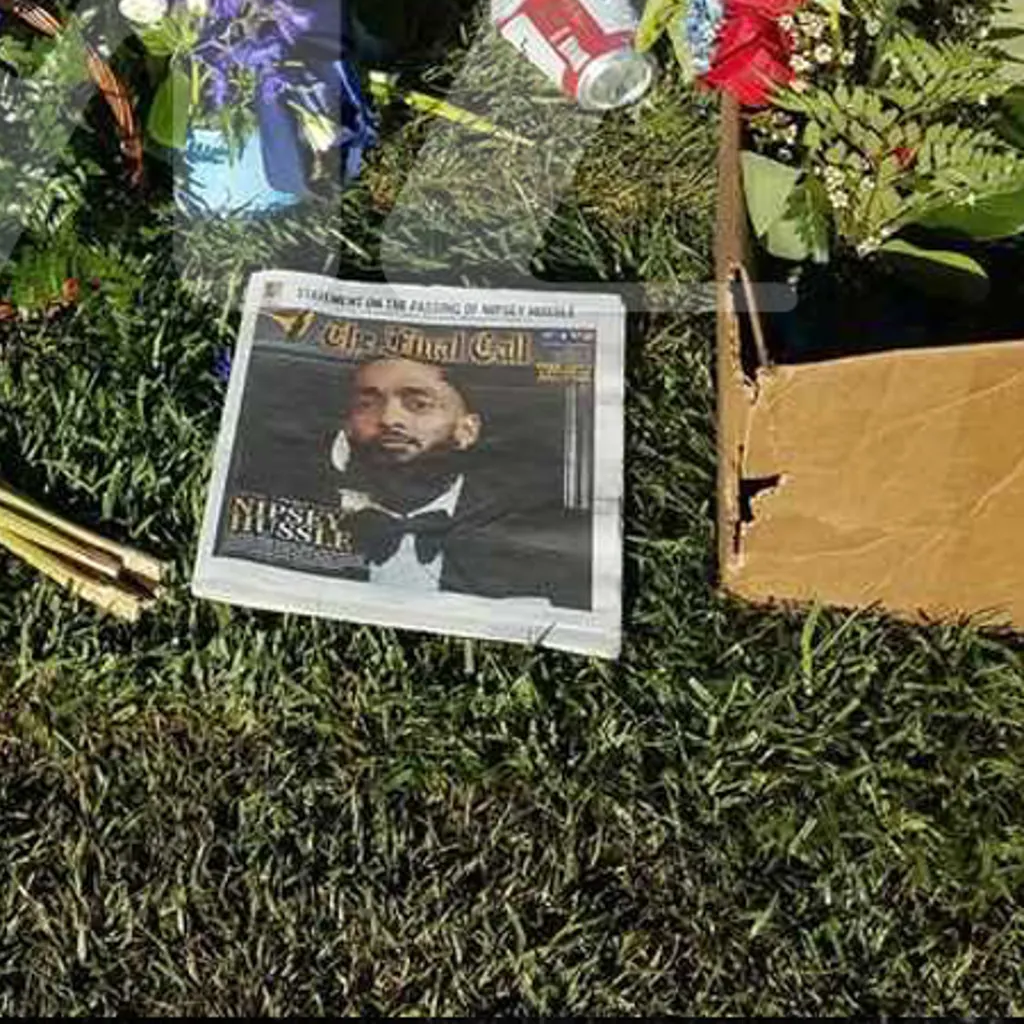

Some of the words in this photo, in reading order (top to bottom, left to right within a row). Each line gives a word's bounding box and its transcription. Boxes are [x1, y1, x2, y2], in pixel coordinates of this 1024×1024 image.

[325, 320, 378, 353] The
[383, 325, 464, 362] Final
[470, 331, 533, 365] Call
[230, 495, 344, 530] NIPSEY
